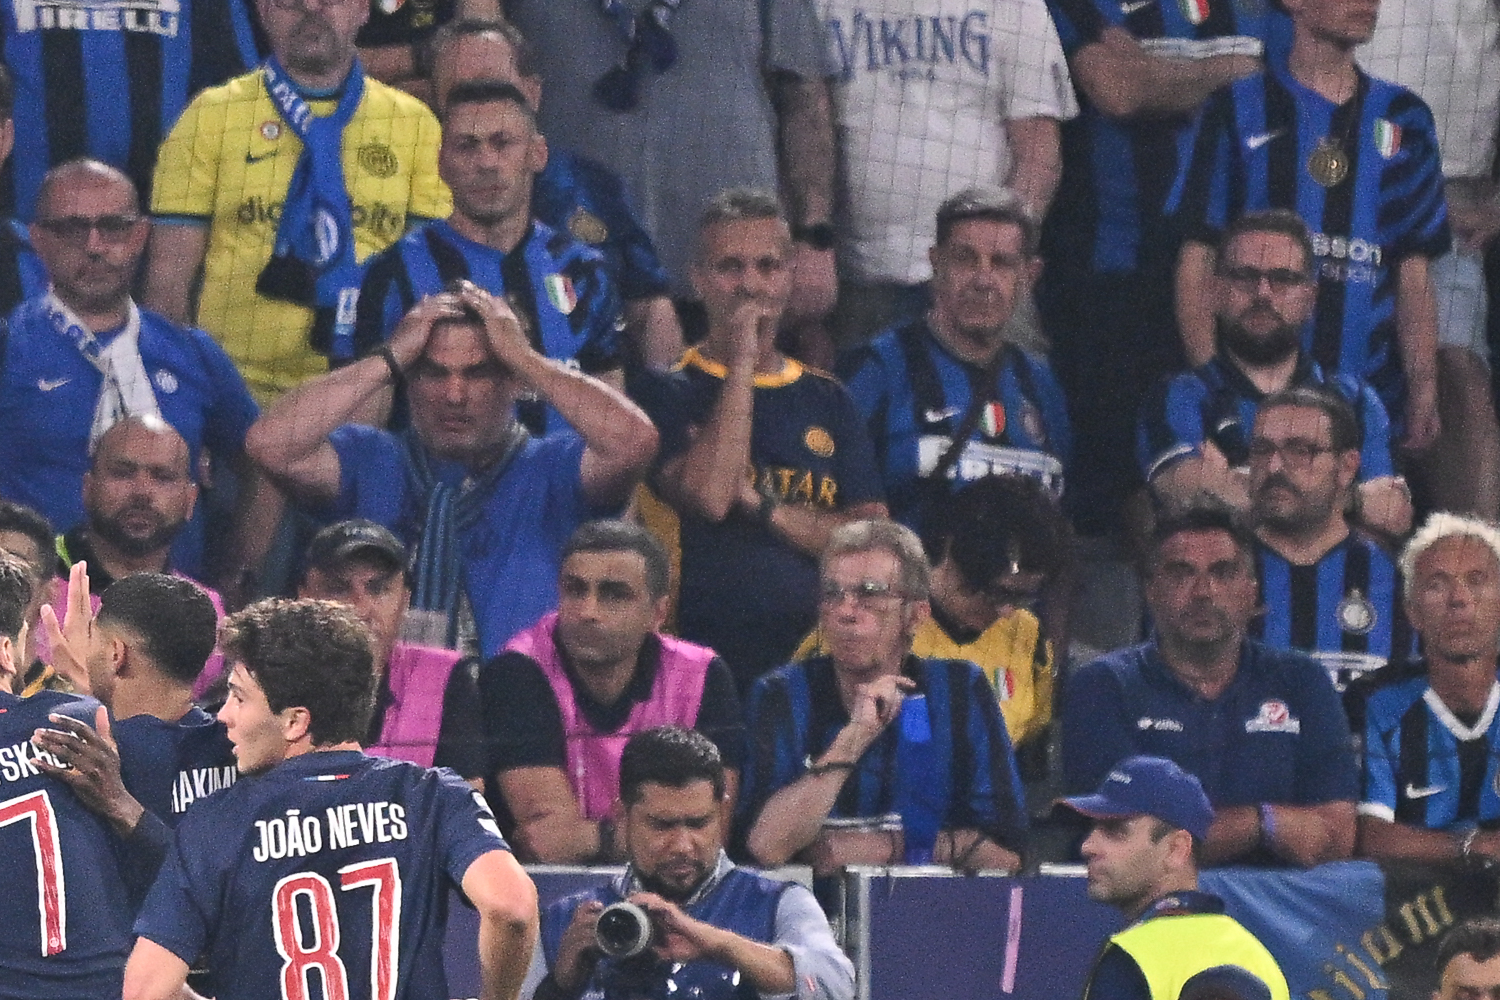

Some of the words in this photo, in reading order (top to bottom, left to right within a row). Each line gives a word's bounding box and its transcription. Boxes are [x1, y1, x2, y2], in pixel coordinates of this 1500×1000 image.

[827, 8, 991, 81] VIKING
[252, 809, 322, 862] JOÃO
[325, 801, 408, 850] NEVES
